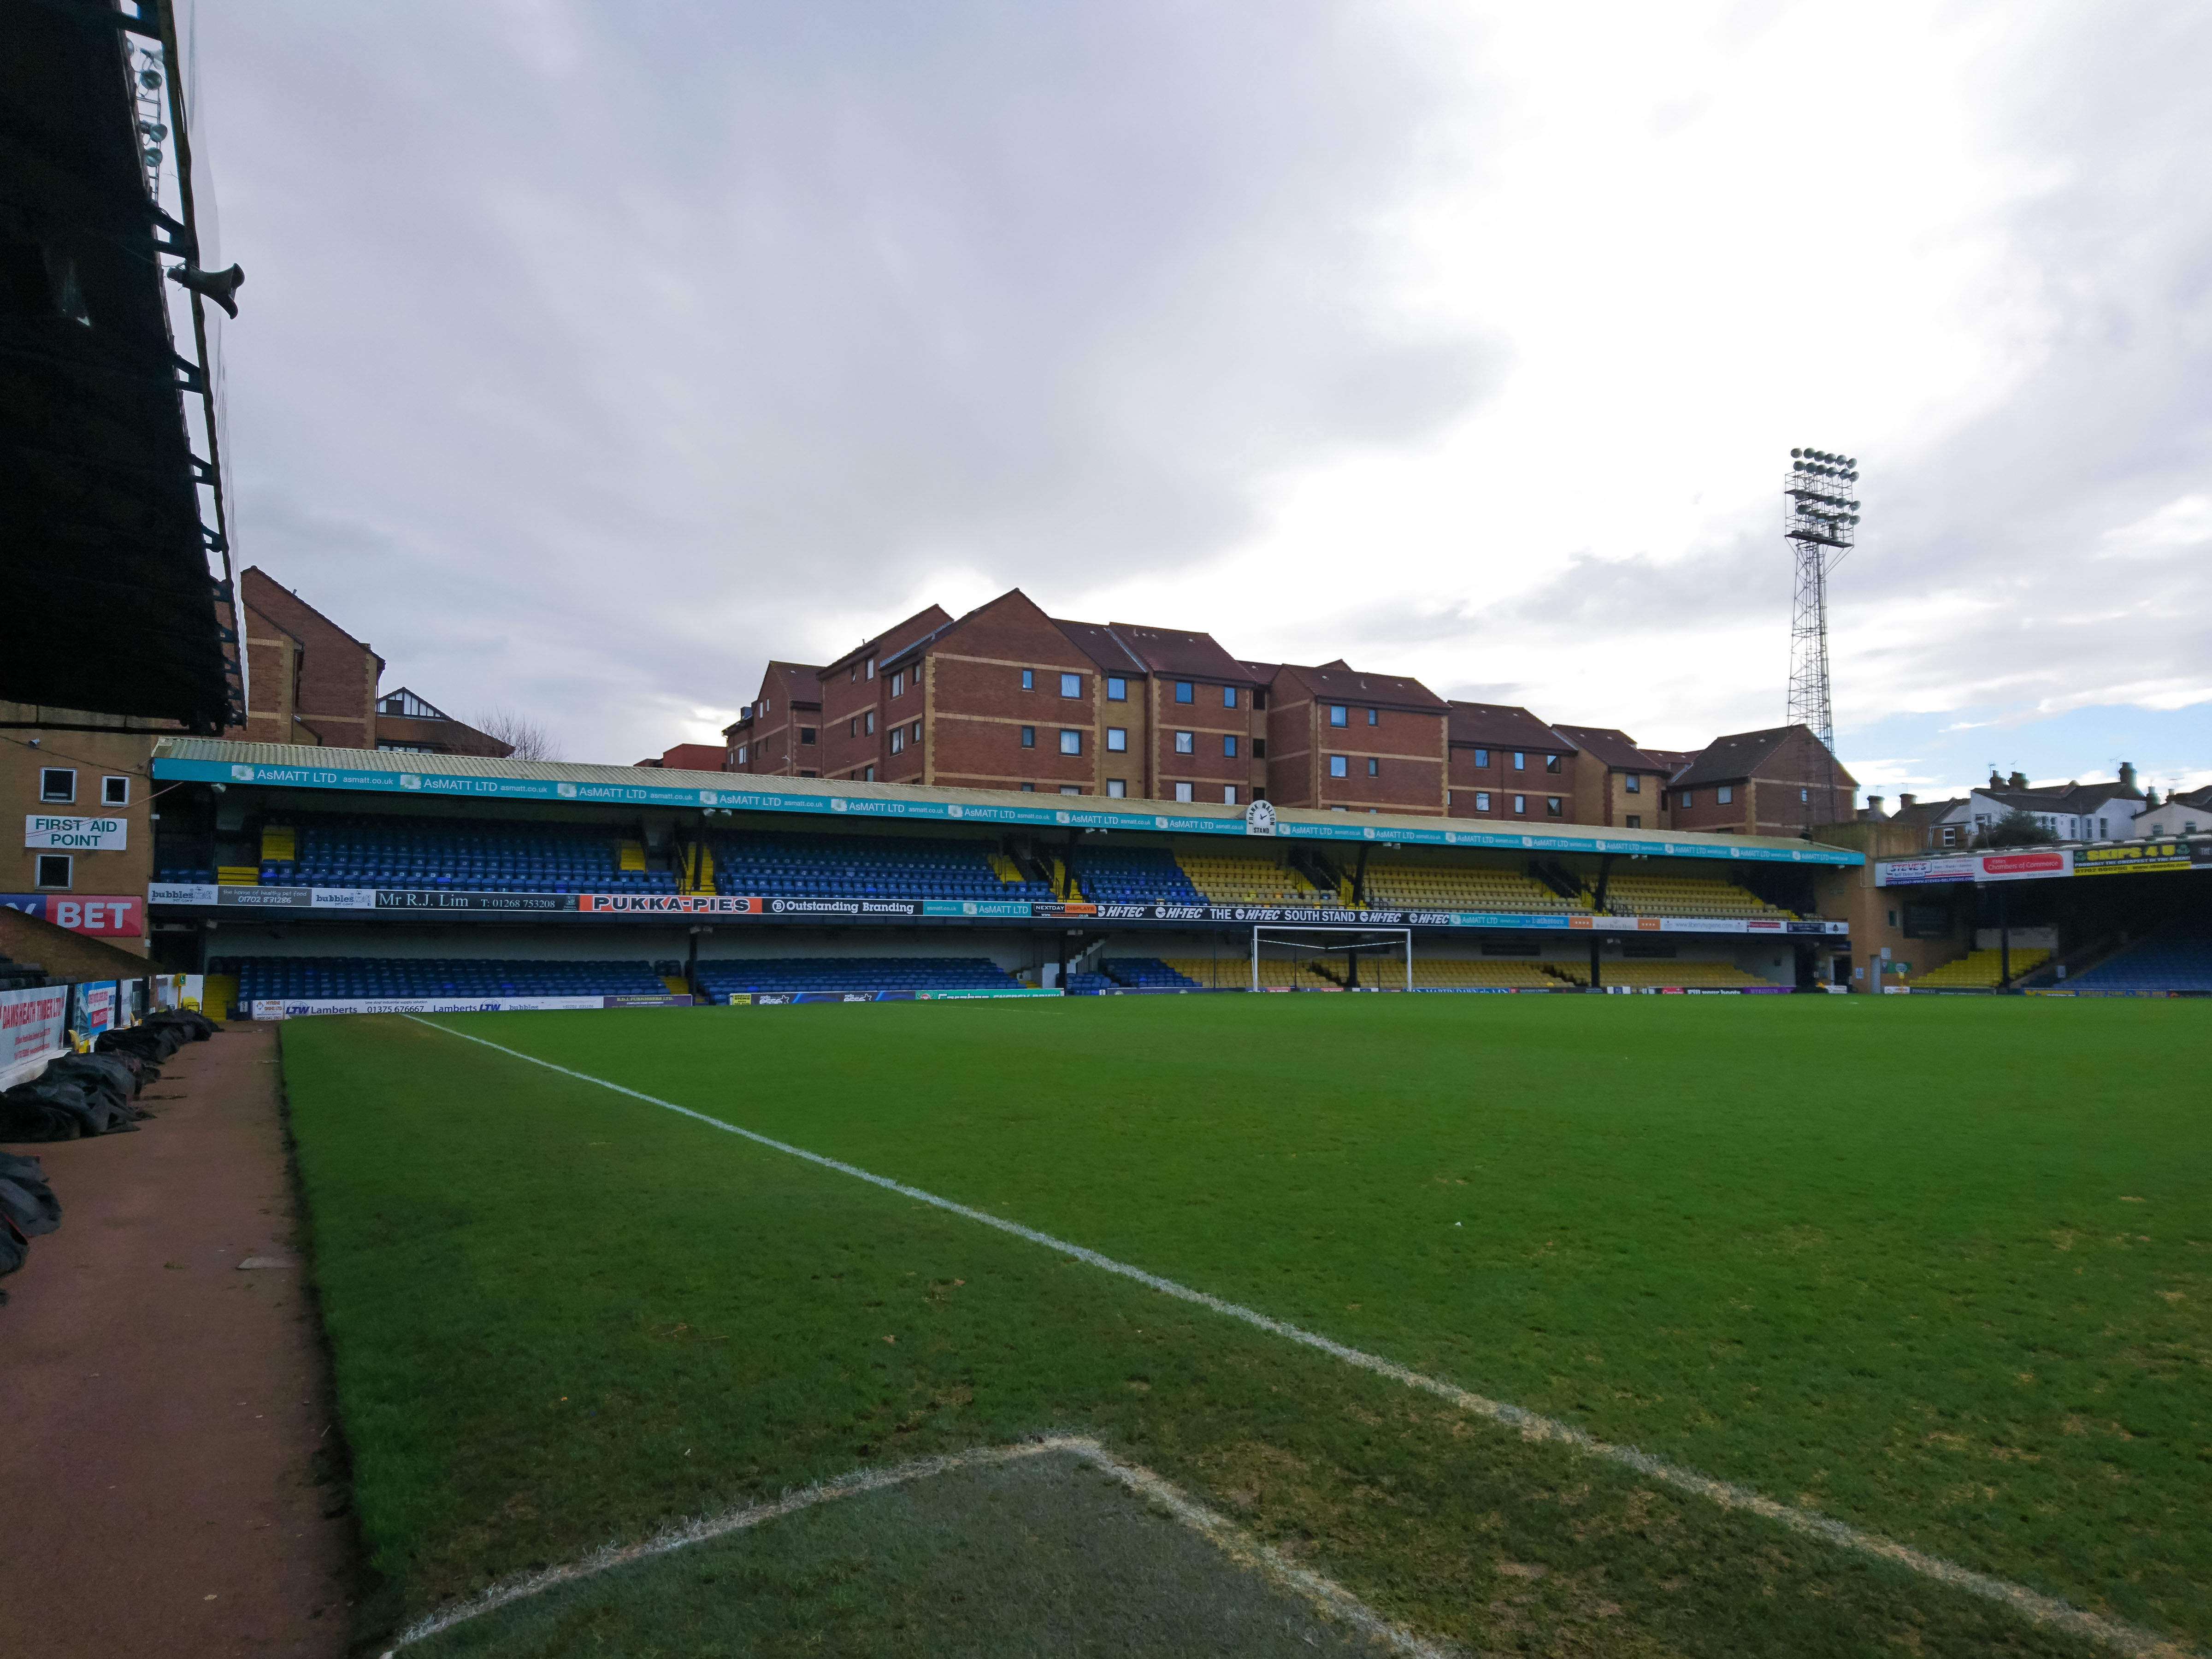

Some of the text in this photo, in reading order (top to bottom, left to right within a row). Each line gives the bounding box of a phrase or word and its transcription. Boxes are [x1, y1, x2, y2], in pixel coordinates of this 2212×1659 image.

[257, 769, 394, 785] AsMATT LTD asmatt.co.uk
[424, 778, 548, 793] AsMATT LTD asmatt.co.uk
[579, 787, 693, 801] AsMATT LTD asmatt.co.uk
[720, 795, 760, 805] AsMATT
[763, 797, 781, 806] LTD
[849, 802, 885, 812] AsMATT
[888, 804, 904, 813] LTD
[964, 809, 998, 817] AsMATT
[1071, 815, 1102, 823] AsMATT
[1249, 803, 1275, 825] FRANK WALTON
[35, 818, 117, 832] FIRST AID
[1169, 820, 1198, 828] AsMATT
[51, 834, 101, 846] POINT
[2087, 847, 2142, 861] SKIPS
[2145, 846, 2159, 857] 4
[152, 891, 194, 899] bubbles
[378, 893, 401, 906] Mr
[406, 894, 433, 907] R.J.
[439, 894, 469, 907] Lim
[493, 899, 520, 908] 01268
[523, 900, 555, 908] 753208
[592, 896, 751, 912] PUKKA-PIES
[786, 901, 914, 915] Outstanding Branding
[979, 905, 1028, 914] AsMATT LTD
[57, 902, 132, 929] BET
[1105, 906, 1145, 917] HI-TEC
[1165, 908, 1204, 919] HI-TEC
[1210, 908, 1356, 922] THE SOUTH STAND
[1245, 909, 1281, 920] HI-TEC
[1368, 913, 1402, 923] HI-TEC
[1417, 914, 1449, 924] HI-TEC
[434, 1004, 477, 1012] Lamberts
